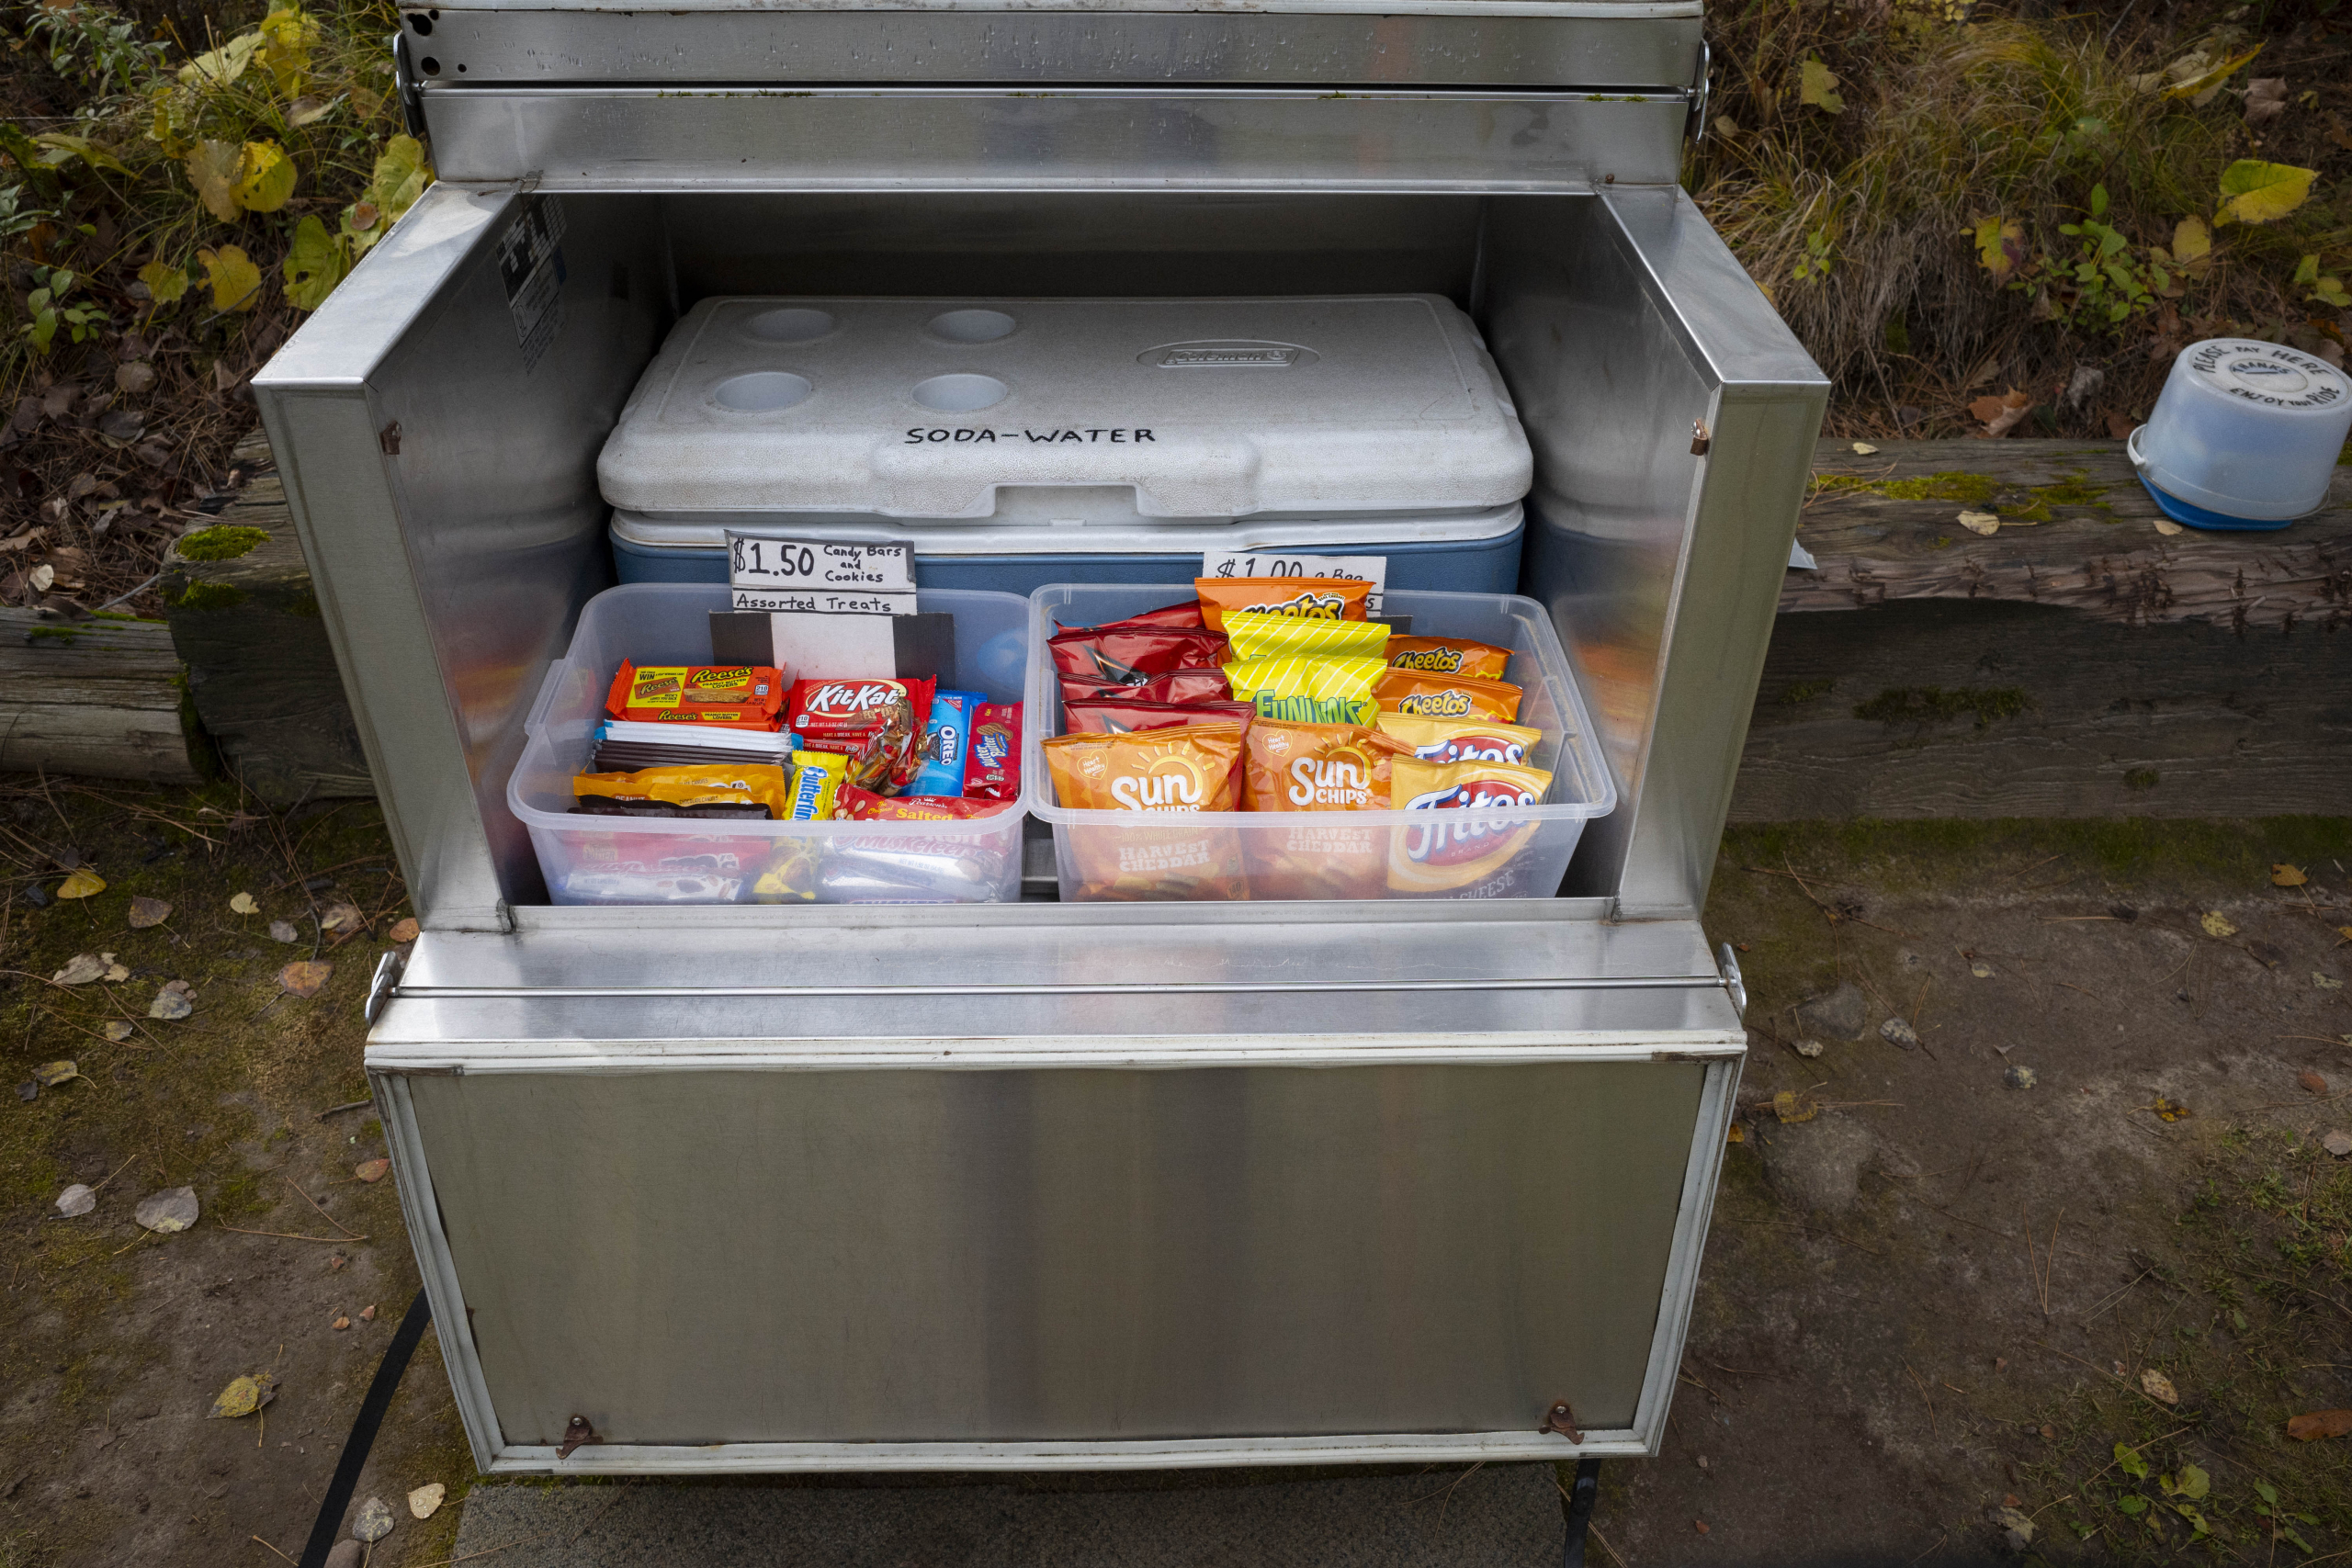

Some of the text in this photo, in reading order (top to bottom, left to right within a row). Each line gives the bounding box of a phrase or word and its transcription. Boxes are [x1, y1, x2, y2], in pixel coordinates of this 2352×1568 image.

[1174, 351, 1263, 361] Coleman
[2192, 345, 2230, 373] PLEASE
[2271, 350, 2332, 375] HERE
[2232, 362, 2290, 374] THANKS
[2229, 388, 2284, 406] ENJOY
[2305, 386, 2341, 405] RIDE
[904, 427, 1157, 444] SODA-WATER
[733, 538, 816, 577] $1.50
[823, 545, 902, 561] Candy Bars
[840, 560, 862, 570] and
[824, 570, 884, 583] Cookies
[736, 592, 892, 612] Assorted Treats
[690, 666, 753, 683] Reese's
[1399, 690, 1472, 716] Cheetos
[658, 710, 697, 720] Reese's
[940, 726, 956, 766] OREO
[984, 736, 1006, 757] Butter
[1268, 735, 1285, 744] Heart
[1268, 741, 1290, 752] Healthy
[976, 745, 1000, 768] Nutter
[1082, 756, 1101, 768] Heart
[1083, 762, 1106, 775] Healthy
[1289, 757, 1372, 807] Sun
[1111, 774, 1203, 811] Sun
[1315, 789, 1367, 805] CHIPS
[867, 805, 894, 815] Original
[896, 807, 953, 821] Salted
[1404, 784, 1536, 863] Fritos
[1121, 827, 1199, 842] 100% WHOLE GRAIN
[1288, 828, 1373, 840] HARVEST
[1118, 840, 1210, 861] HARVEST
[1286, 840, 1374, 854] CHEDDAR
[1451, 841, 1490, 857] BRAND
[1119, 852, 1211, 872] CHEDDAR
